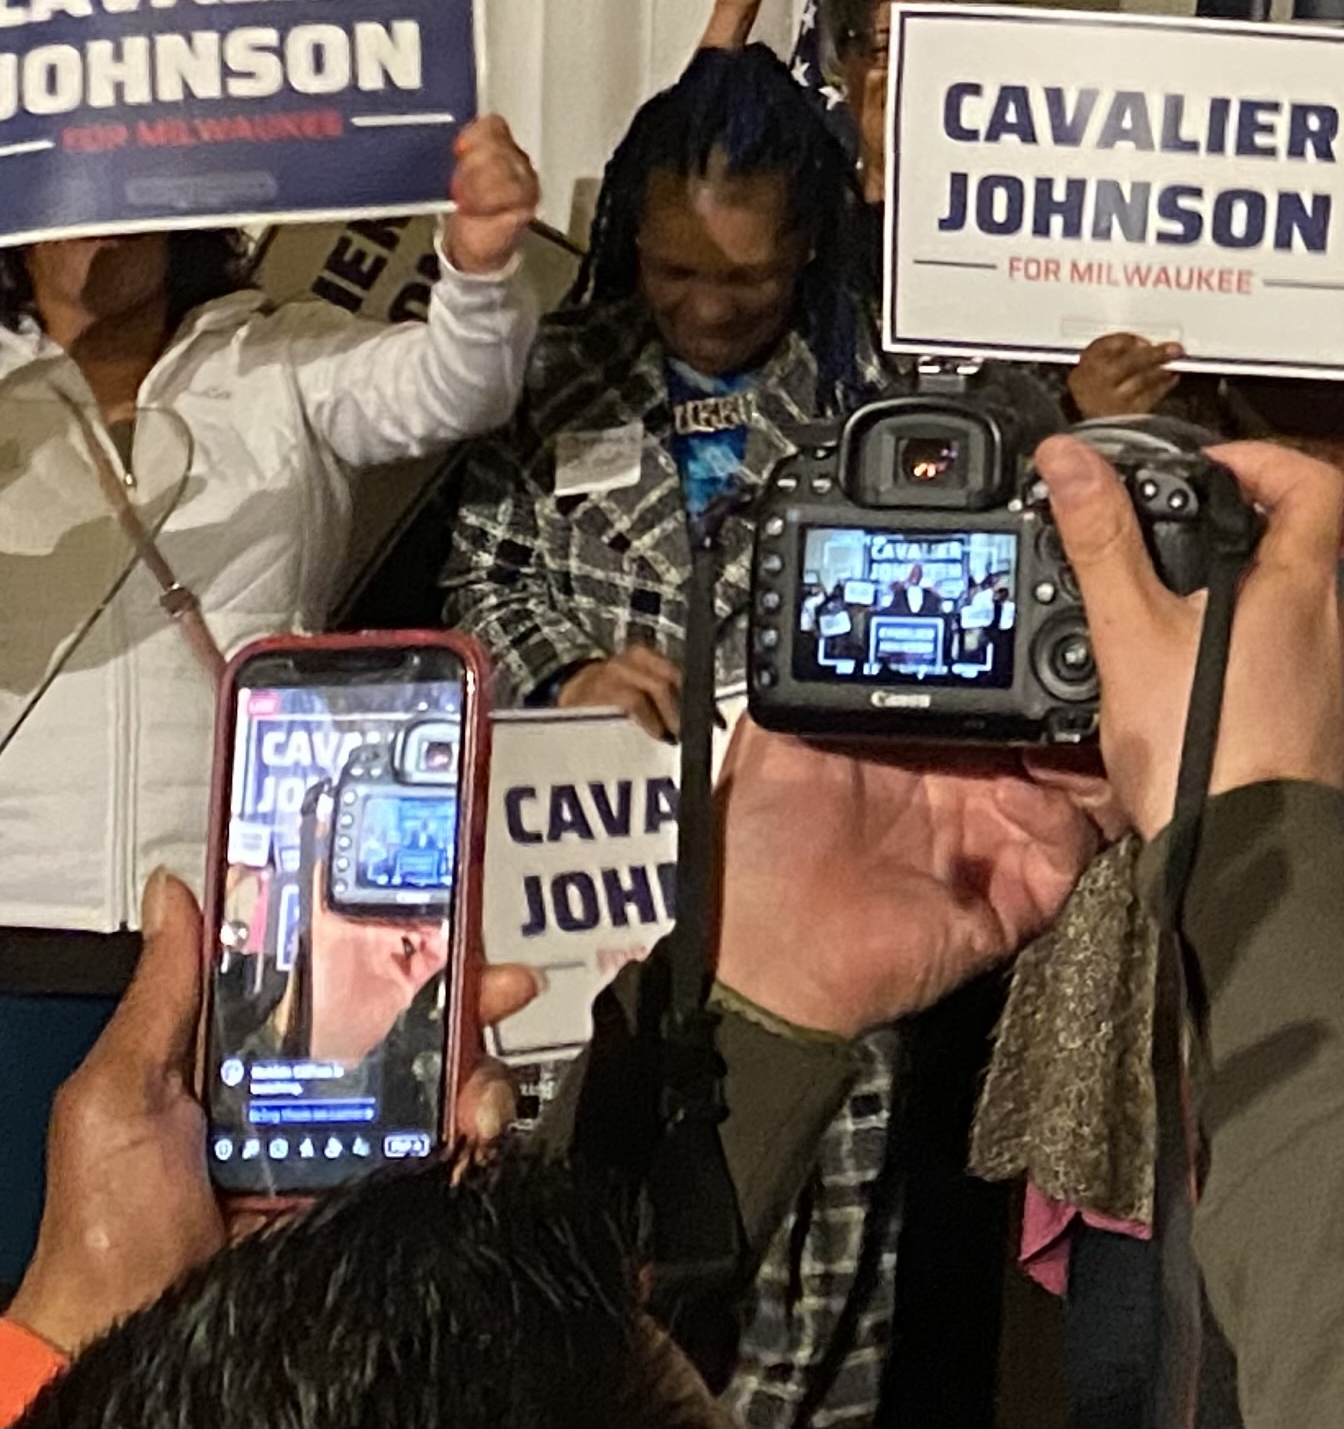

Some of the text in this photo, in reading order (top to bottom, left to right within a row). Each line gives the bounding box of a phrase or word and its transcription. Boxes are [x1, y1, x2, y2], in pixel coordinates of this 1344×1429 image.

[944, 82, 1339, 163] CAVALIER
[938, 172, 1332, 254] JOHNSON
[1008, 256, 1253, 294] FOR MILWAUKEE
